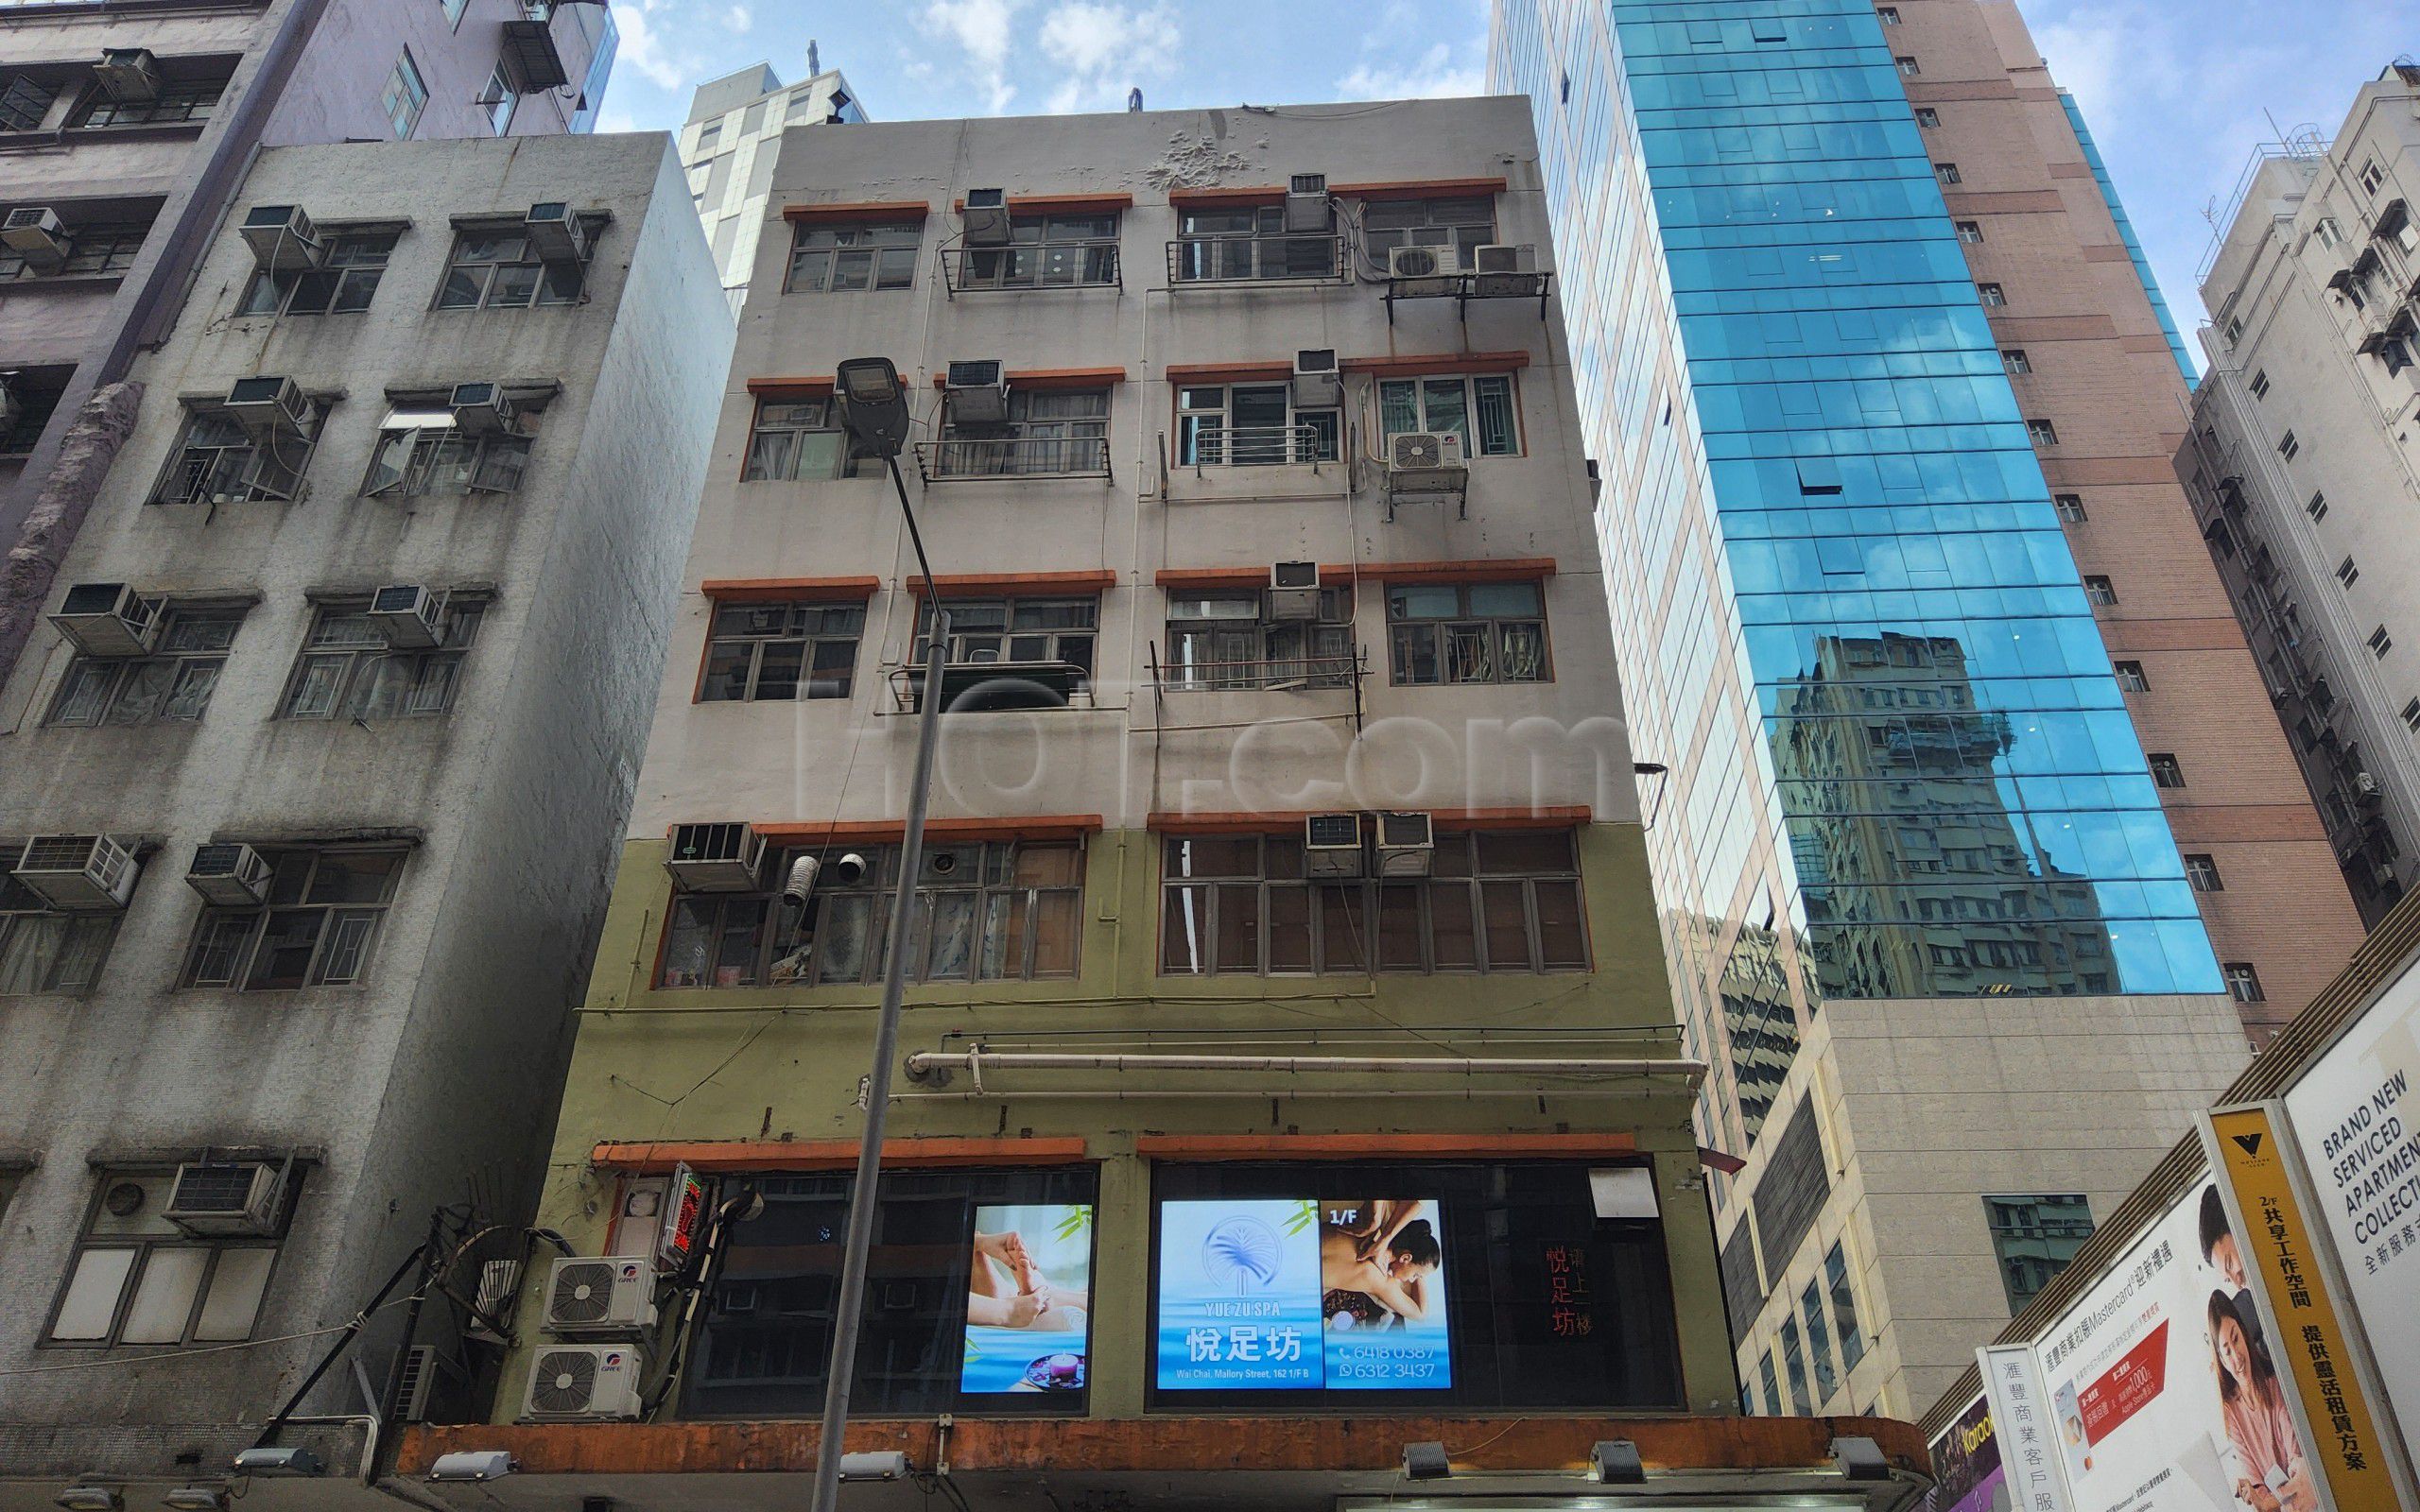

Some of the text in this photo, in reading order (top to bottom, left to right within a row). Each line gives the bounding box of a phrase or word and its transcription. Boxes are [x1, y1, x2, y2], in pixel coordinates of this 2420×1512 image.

[2323, 1069, 2408, 1160] BRAND NEW
[2333, 1116, 2401, 1189] SERVICED
[2345, 1132, 2420, 1217] APARTMEN
[1330, 1210, 1357, 1226] 1/F
[1204, 1301, 1281, 1317] YUE ZU SPA
[1354, 1346, 1435, 1359] 6418 0387
[1215, 1369, 1243, 1380] Mallory
[1355, 1364, 1435, 1378] 6312 3437
